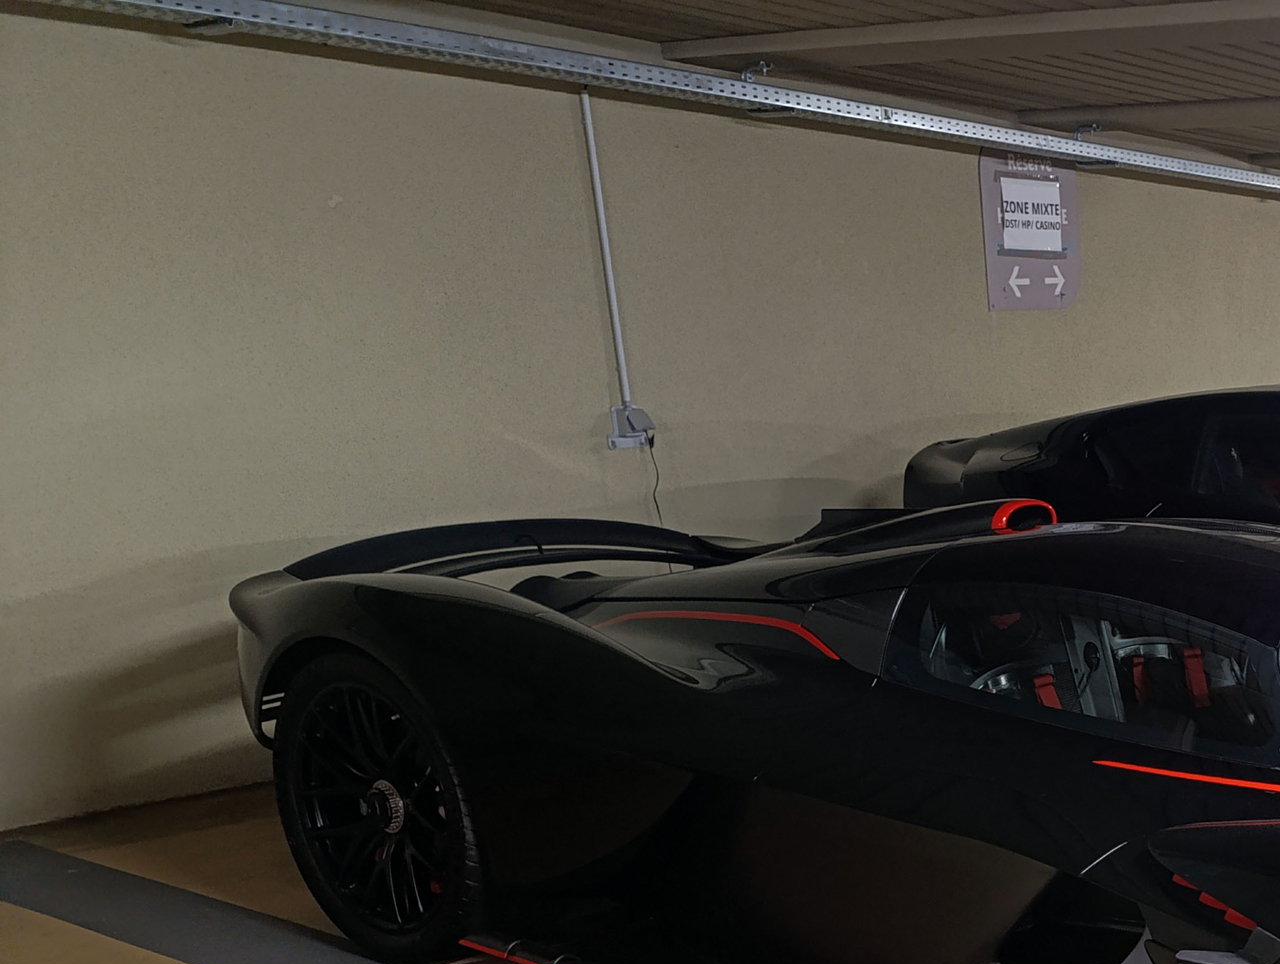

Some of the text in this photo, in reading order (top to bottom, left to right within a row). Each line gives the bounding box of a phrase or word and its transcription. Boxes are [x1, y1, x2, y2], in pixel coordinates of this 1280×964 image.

[1003, 200, 1029, 215] ZONE
[1031, 202, 1060, 216] MIXTE
[1035, 220, 1061, 231] CASINO
